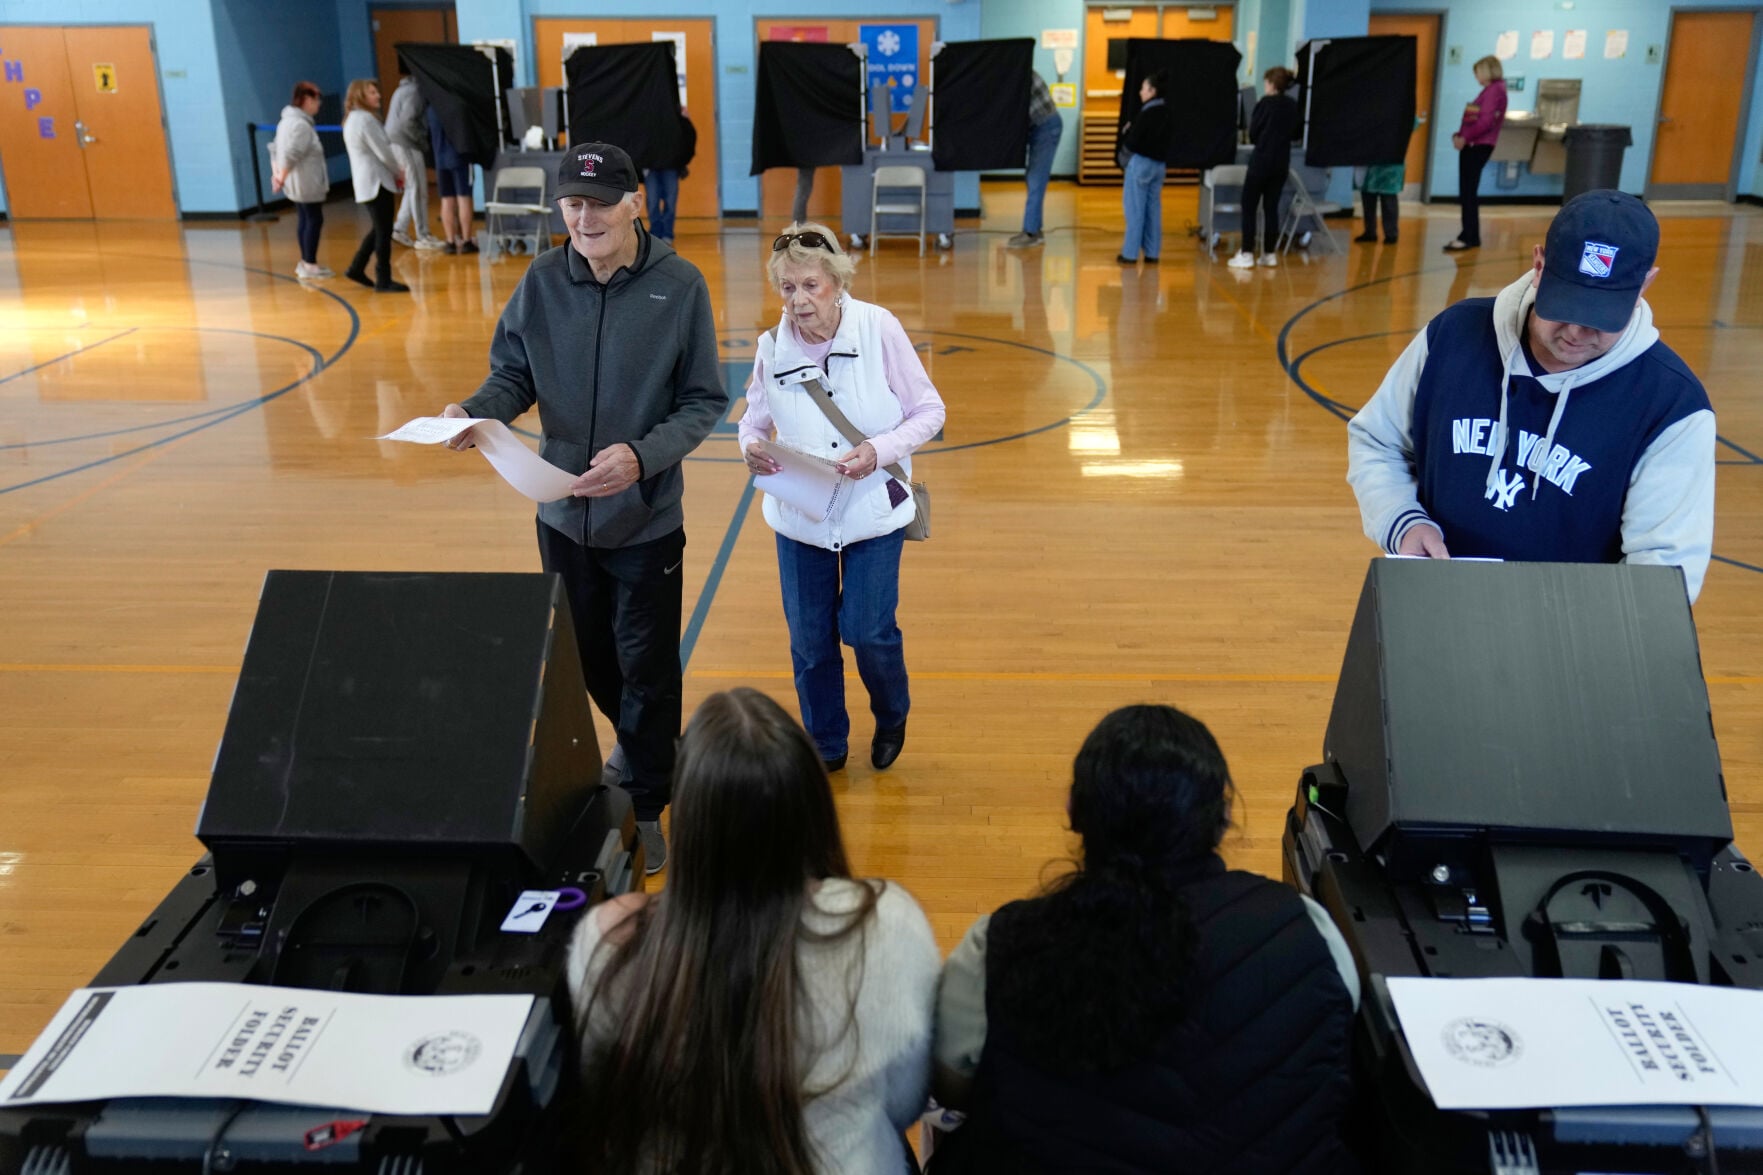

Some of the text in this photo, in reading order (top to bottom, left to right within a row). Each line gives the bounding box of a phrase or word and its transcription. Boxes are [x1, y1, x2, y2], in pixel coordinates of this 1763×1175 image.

[577, 153, 603, 164] STEVENS
[584, 159, 595, 173] S
[1516, 430, 1593, 496] YORK
[215, 1010, 269, 1069] FOLDER
[238, 1006, 298, 1077] SECURITY
[271, 1016, 320, 1071] BALLOT
[1606, 1007, 1660, 1070] BALLOT
[1627, 1002, 1695, 1083] SECURITY
[1659, 1011, 1717, 1074] FOLDER
